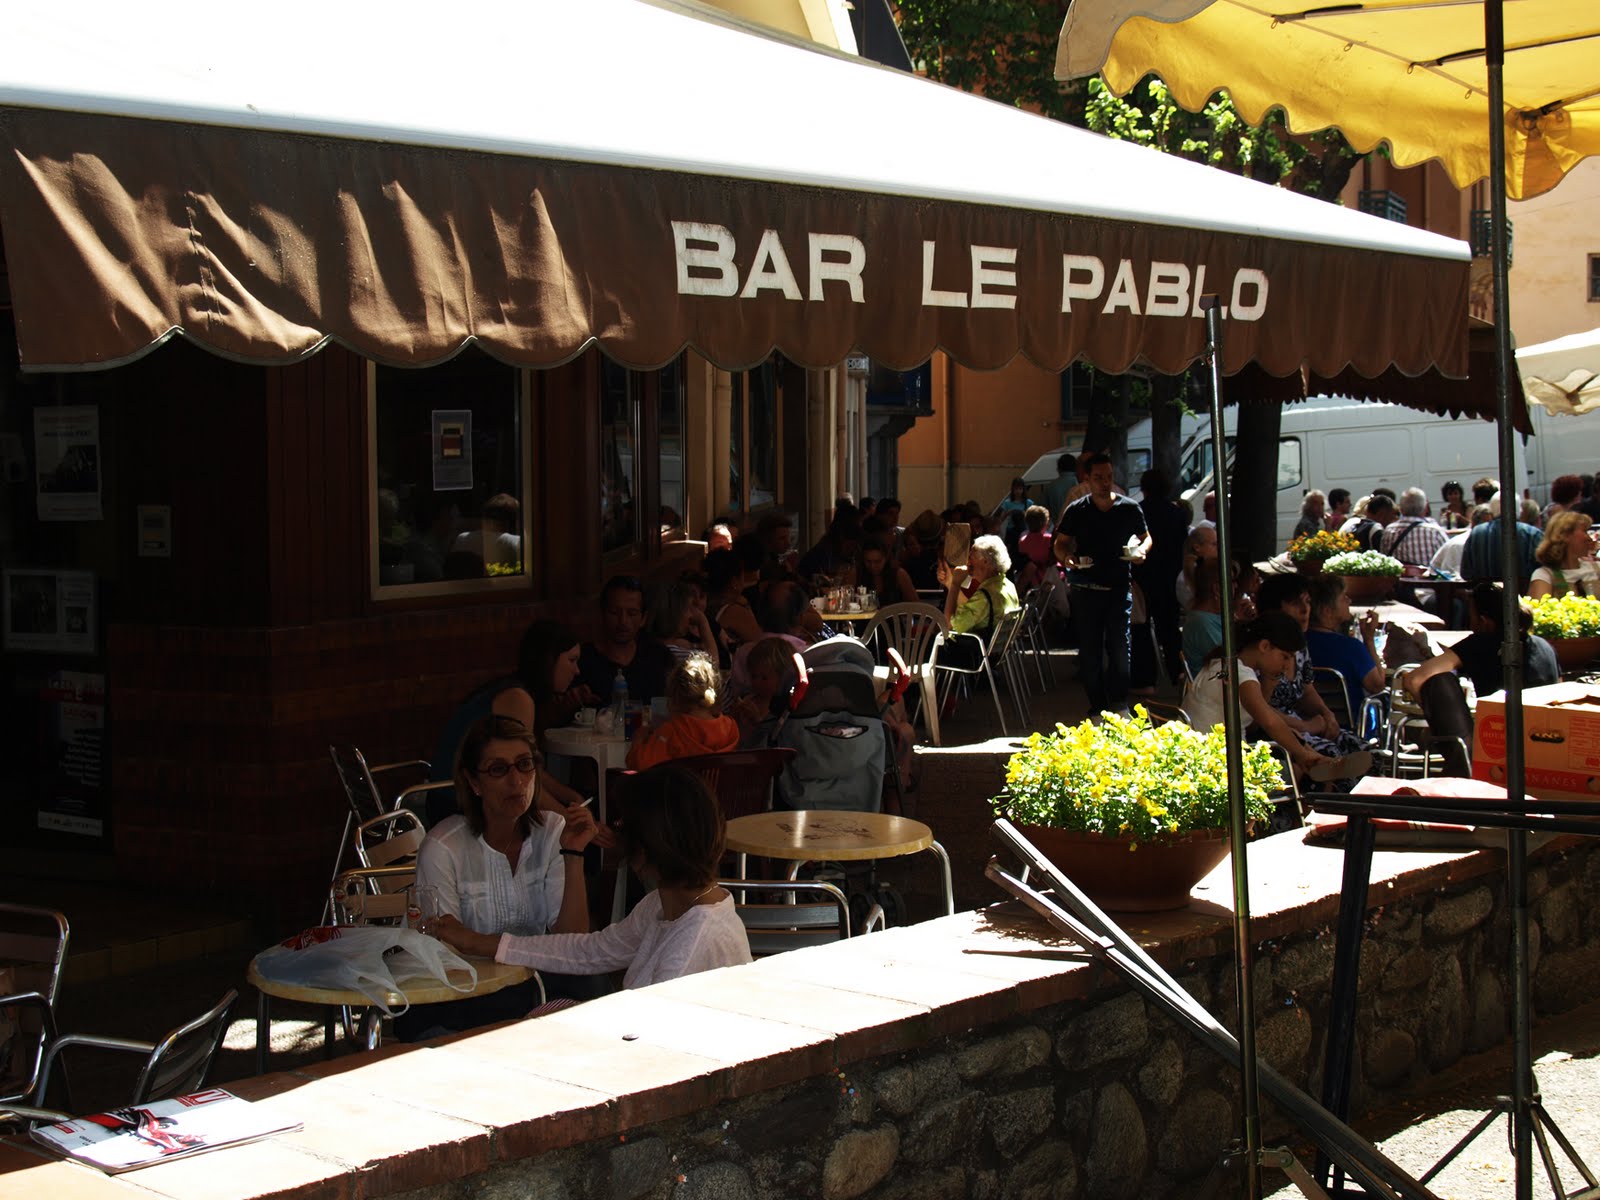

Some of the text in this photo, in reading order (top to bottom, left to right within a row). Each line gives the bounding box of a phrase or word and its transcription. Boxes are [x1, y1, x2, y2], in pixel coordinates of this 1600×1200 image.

[671, 220, 1270, 322] BAR LE PABLO
